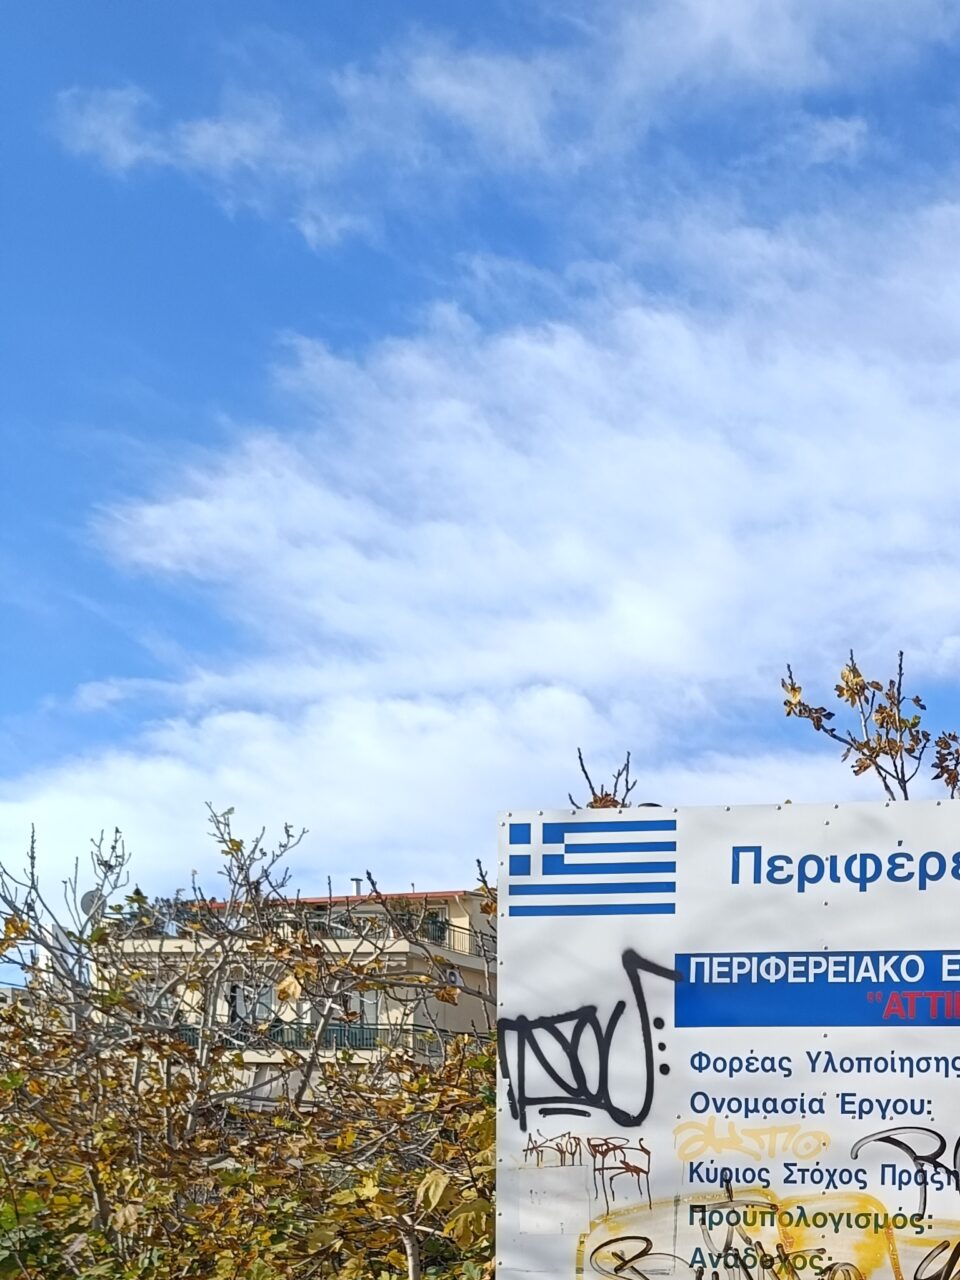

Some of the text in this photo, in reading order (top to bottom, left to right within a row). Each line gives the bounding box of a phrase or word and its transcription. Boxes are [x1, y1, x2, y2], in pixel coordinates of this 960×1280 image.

[689, 954, 925, 984] ΠΕΡΙΦΕΡΕΙΑΚΟ
[690, 1049, 792, 1078] Φορέας
[690, 1092, 826, 1119] Ονομασία
[835, 1091, 932, 1119] Έργου:
[689, 1160, 770, 1188] Κύριος
[783, 1161, 867, 1189] Στόχος
[689, 1204, 933, 1234] Προϋπολογισμός:
